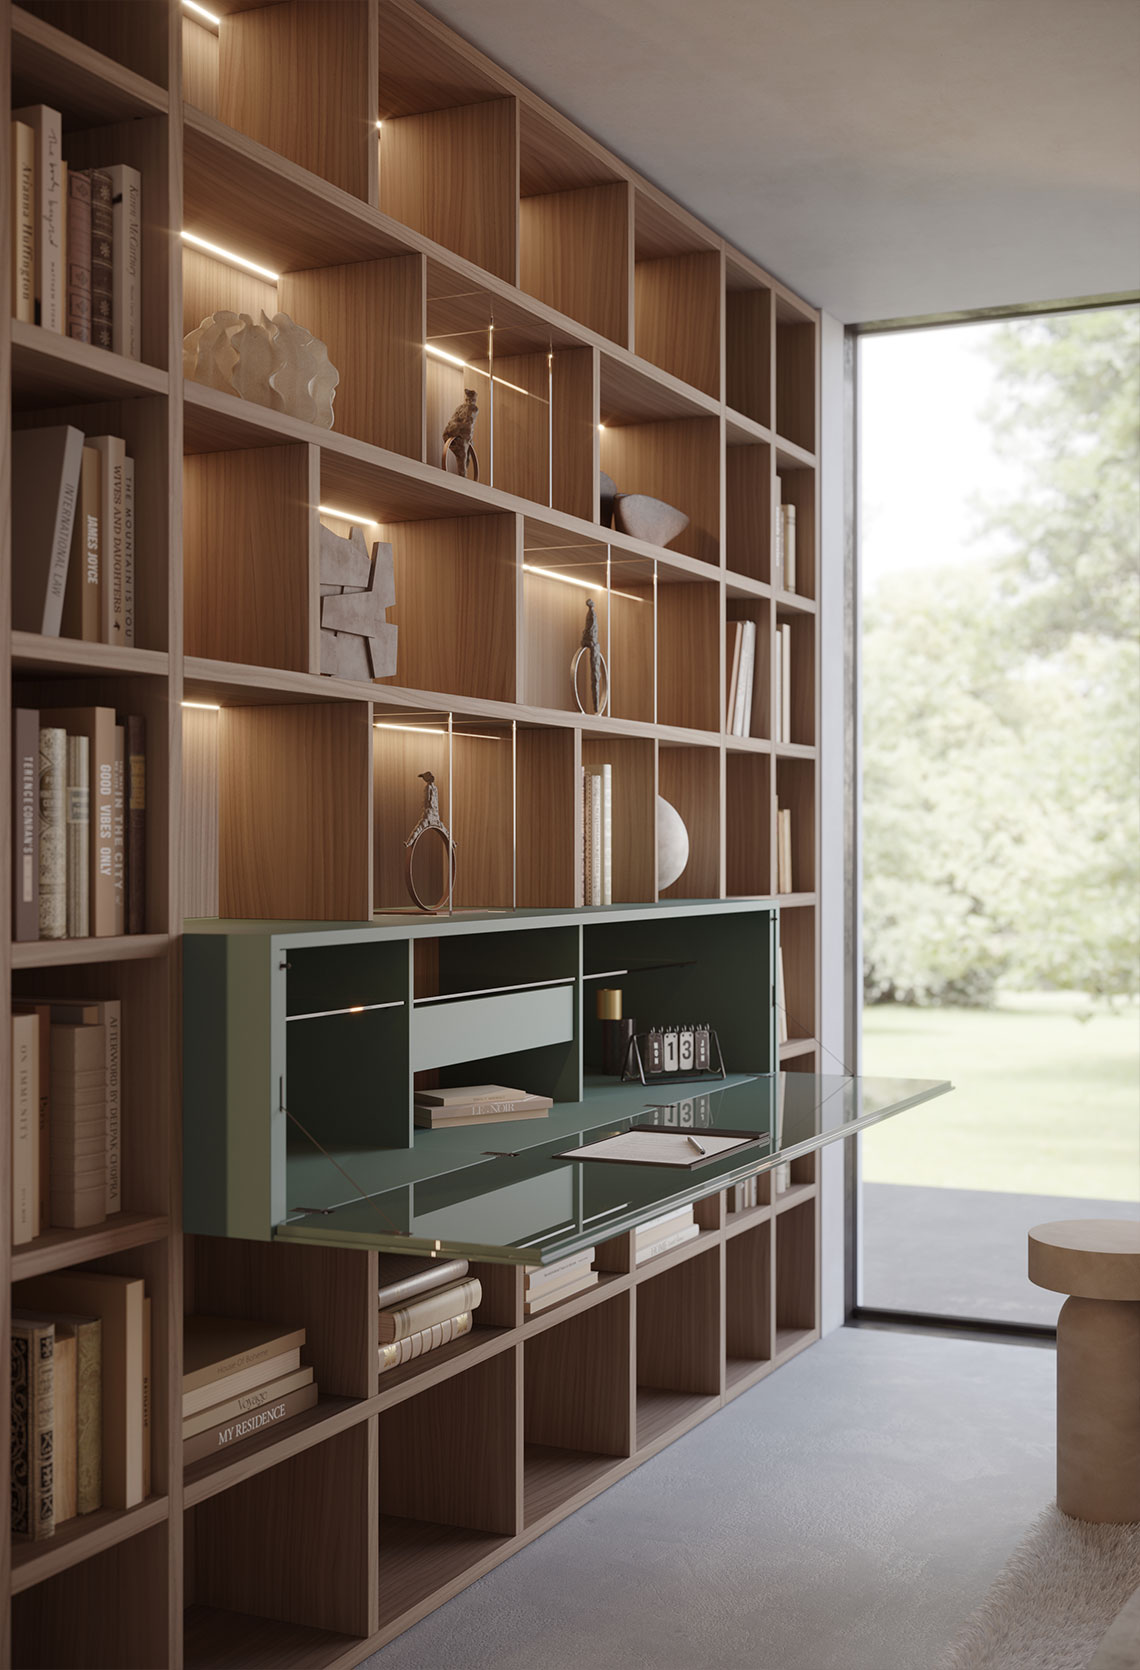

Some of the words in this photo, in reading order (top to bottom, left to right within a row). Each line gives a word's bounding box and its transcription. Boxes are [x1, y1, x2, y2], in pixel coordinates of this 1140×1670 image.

[22, 163, 32, 218] Arianna
[128, 185, 139, 218] Karen
[19, 223, 33, 301] Huffington
[126, 222, 139, 277] McCartney
[113, 465, 121, 505] WIVES
[54, 483, 75, 569] INTERNATIONAL
[87, 514, 98, 549] JAMES
[113, 507, 121, 535] AND
[51, 572, 64, 598] LAW
[87, 552, 98, 584] JOYCE
[113, 538, 122, 614] DAUGHTERS
[125, 589, 132, 603] IS
[22, 756, 33, 803] TERENCE
[100, 764, 112, 795] GOOD
[114, 791, 123, 807] IN
[22, 805, 33, 854] CONRAN'S
[100, 805, 112, 838] VIBES
[114, 814, 123, 847] THE
[100, 847, 112, 876] ONLY
[114, 853, 123, 889] CITY
[20, 1045, 28, 1063] ON
[109, 1016, 118, 1087] AFTERWORD
[667, 1039, 691, 1061] 13
[20, 1070, 28, 1141] IMMUNITY
[109, 1090, 118, 1104] BY
[490, 1103, 515, 1114] NOIR
[109, 1108, 118, 1151] DEEPAK
[109, 1153, 118, 1199] CHOPRA
[218, 1426, 235, 1445] MY
[235, 1404, 286, 1437] RESIDENCE
